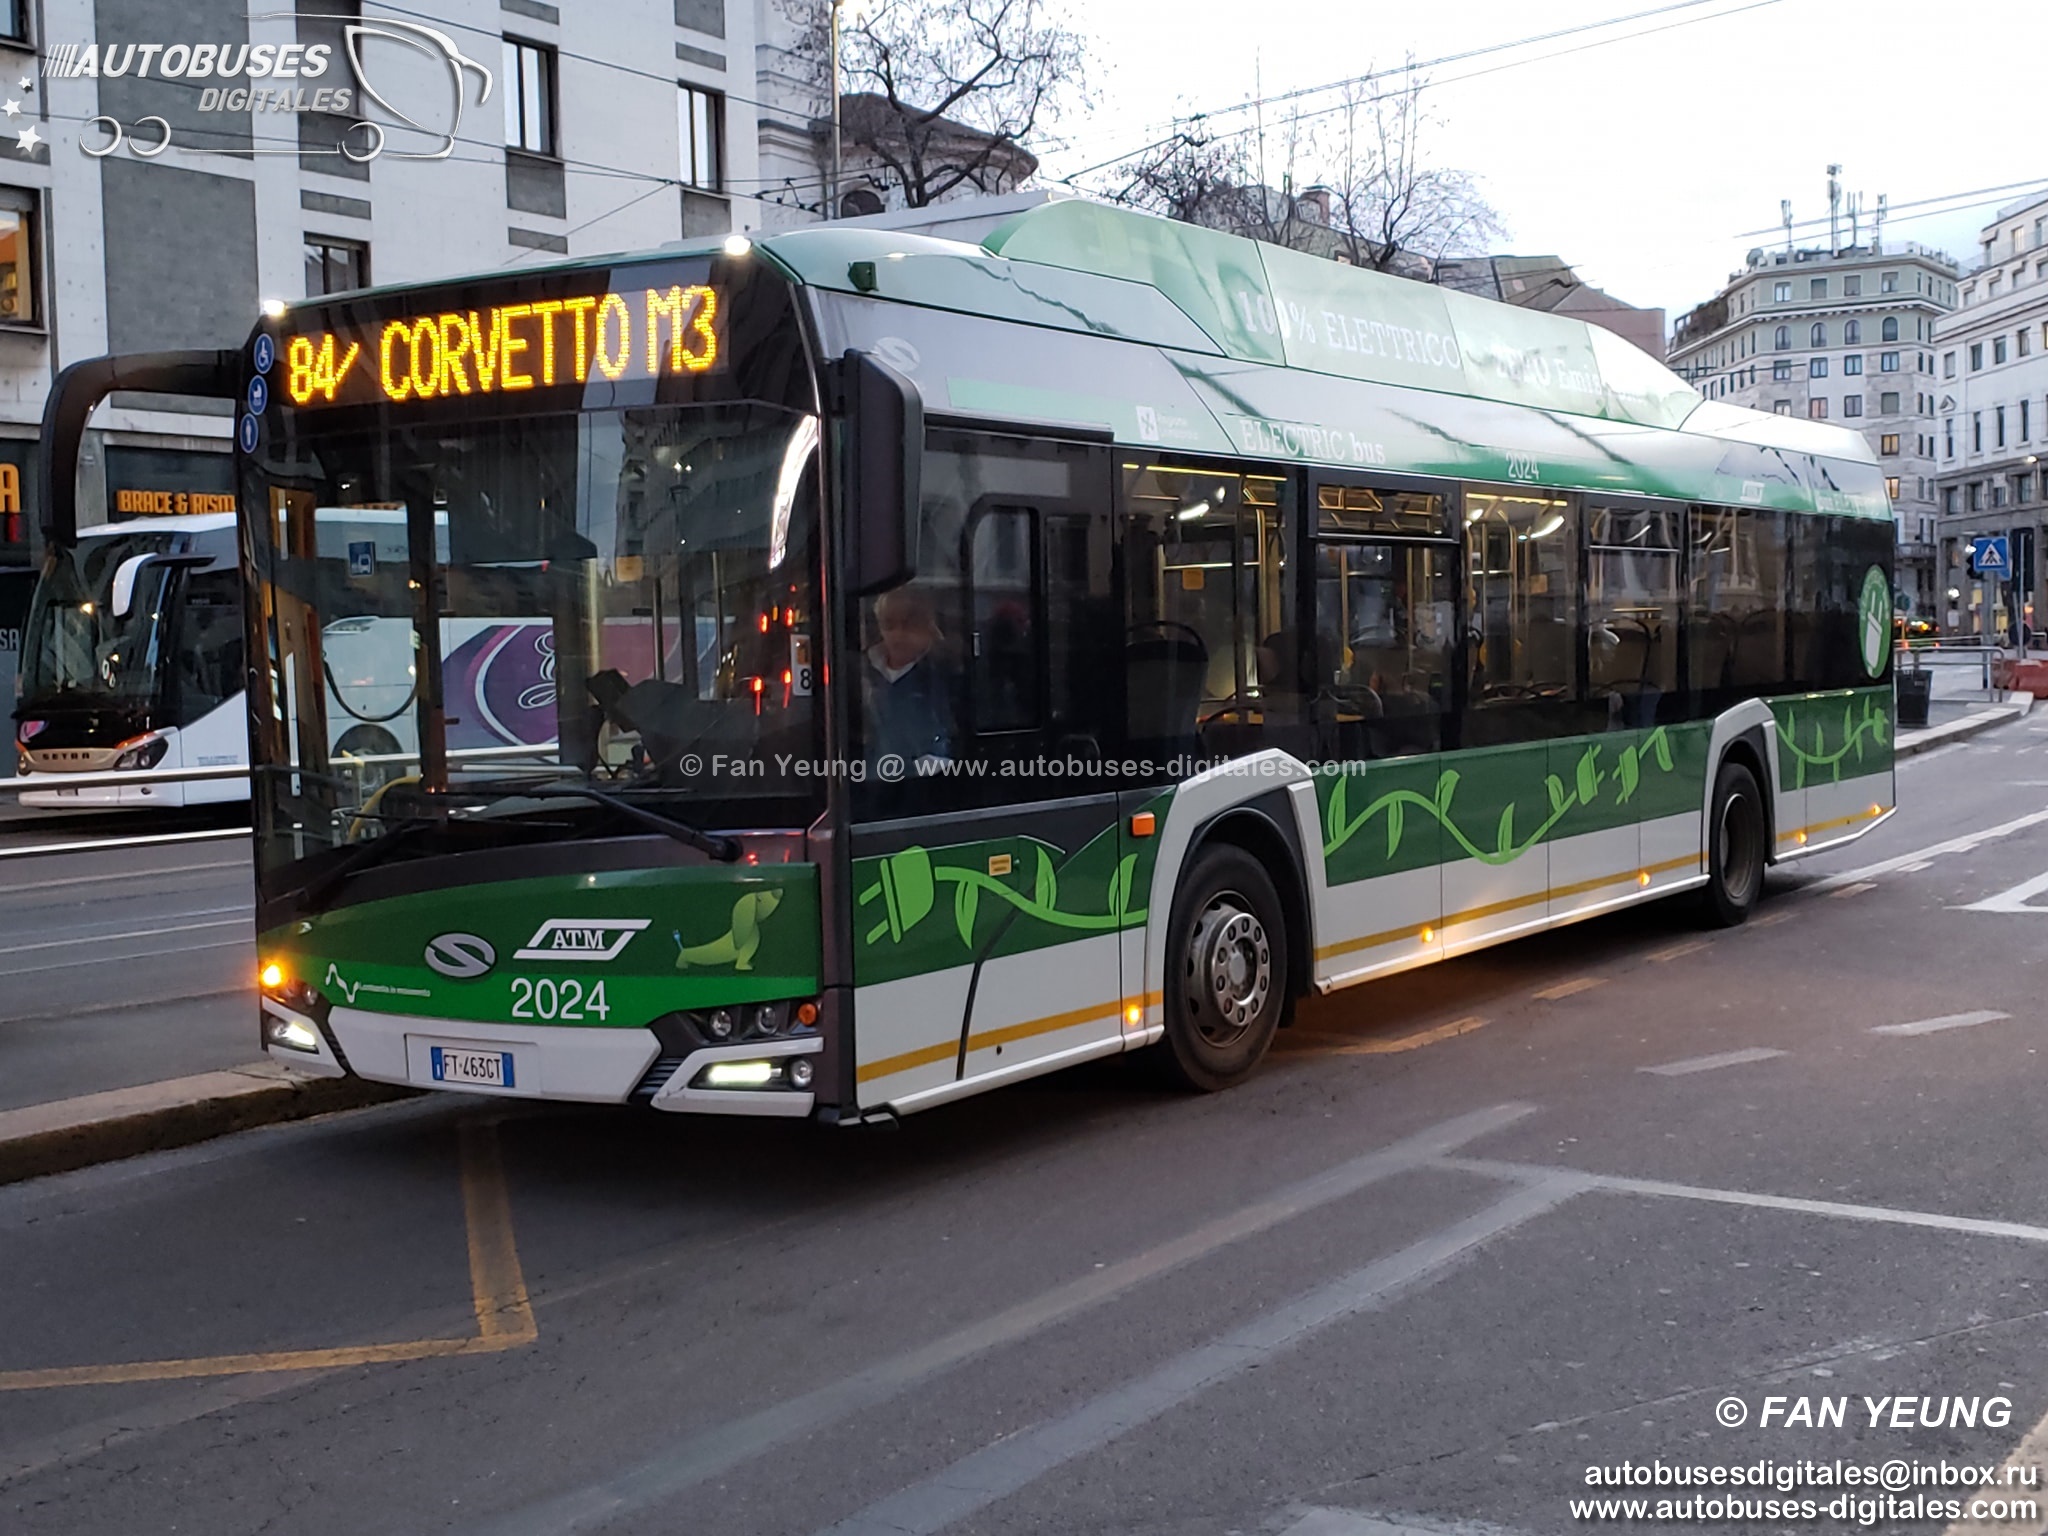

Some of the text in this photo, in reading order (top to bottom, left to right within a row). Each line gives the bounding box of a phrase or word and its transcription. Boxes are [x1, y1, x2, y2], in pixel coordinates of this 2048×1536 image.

[379, 293, 631, 401] CORVETTO
[646, 284, 718, 374] M3
[1320, 311, 1460, 370] ELETTRICO
[1239, 419, 1346, 461] ELECTRIC
[1349, 432, 1386, 465] bus
[1505, 450, 1539, 481] 2024
[116, 489, 174, 514] BRACE
[175, 494, 188, 515] &
[551, 929, 606, 950] ATM
[511, 977, 610, 1021] 2024
